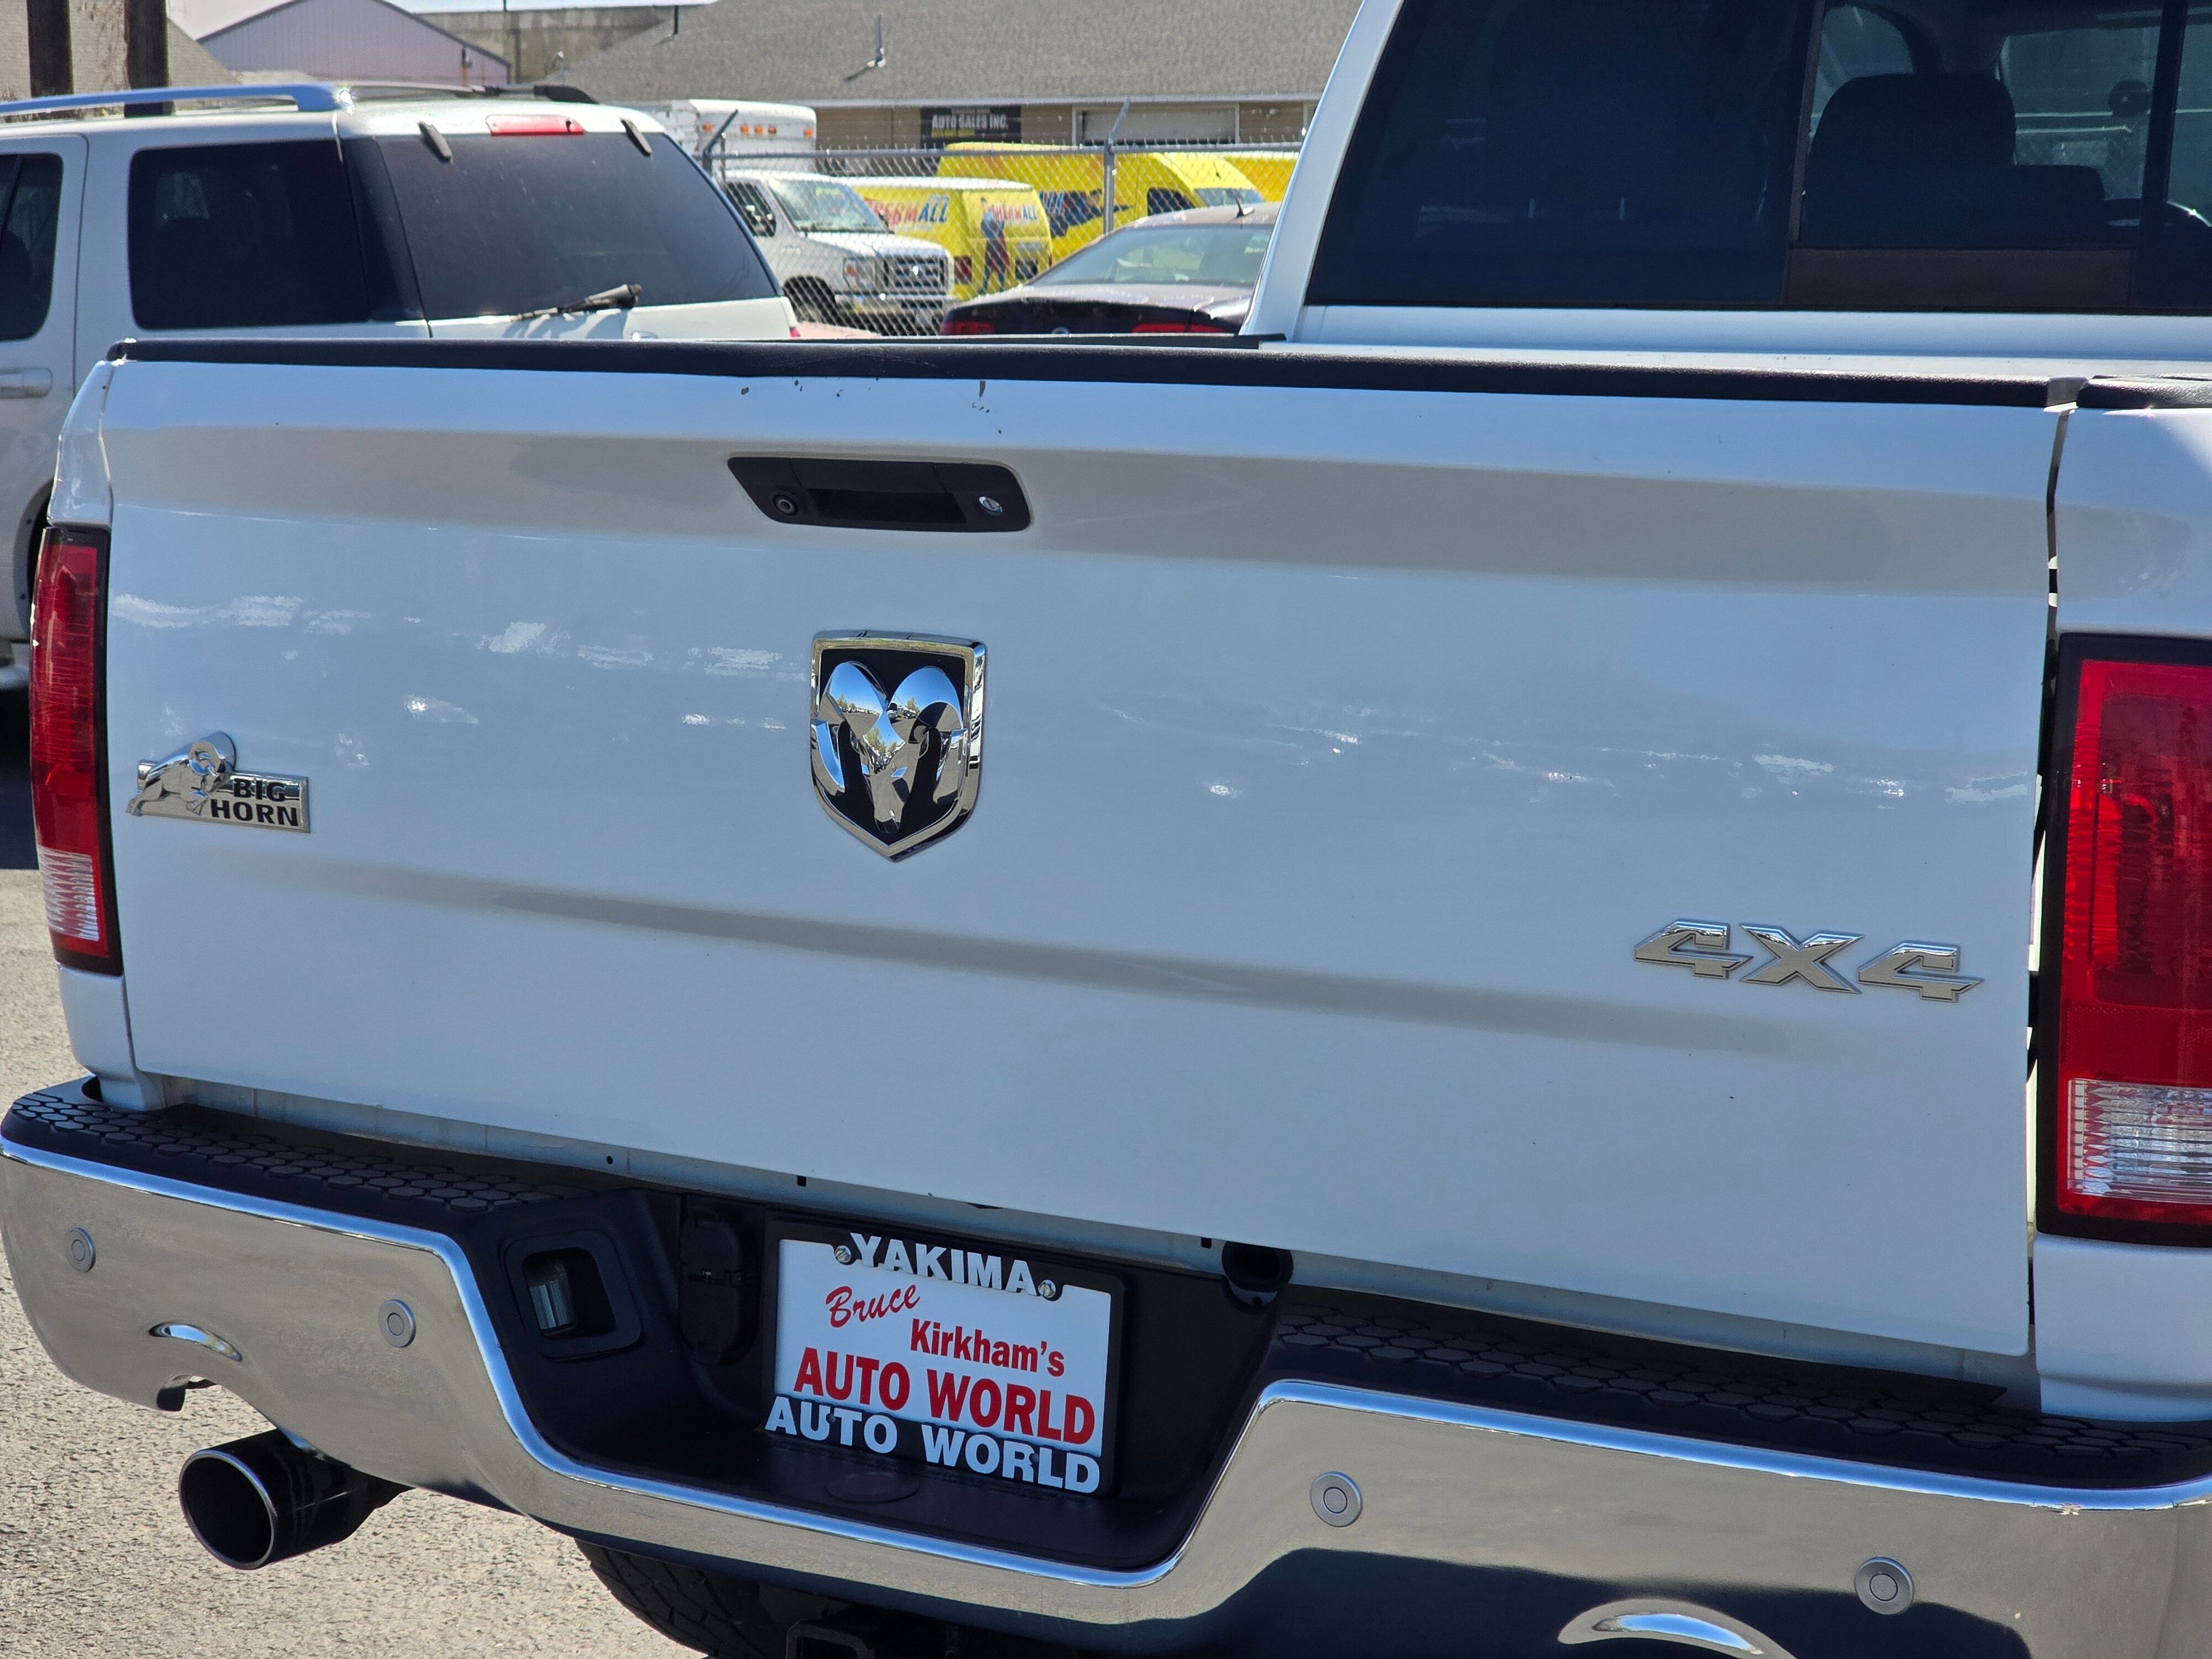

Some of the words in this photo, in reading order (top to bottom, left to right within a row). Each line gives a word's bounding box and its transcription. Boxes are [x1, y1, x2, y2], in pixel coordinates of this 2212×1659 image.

[931, 114, 957, 129] AUTO
[958, 114, 988, 131] SALES
[210, 799, 299, 827] HORN
[233, 778, 286, 802] BIG
[1634, 918, 1985, 1003] 4X4
[849, 1232, 1037, 1296] YAKIMA
[825, 1284, 921, 1328] Bruce
[910, 1318, 1065, 1377] Kirkham's
[793, 1347, 910, 1411] AUTO
[926, 1369, 1095, 1445] WORLD
[764, 1395, 898, 1454] AUTO
[921, 1423, 1100, 1494] WORLD
